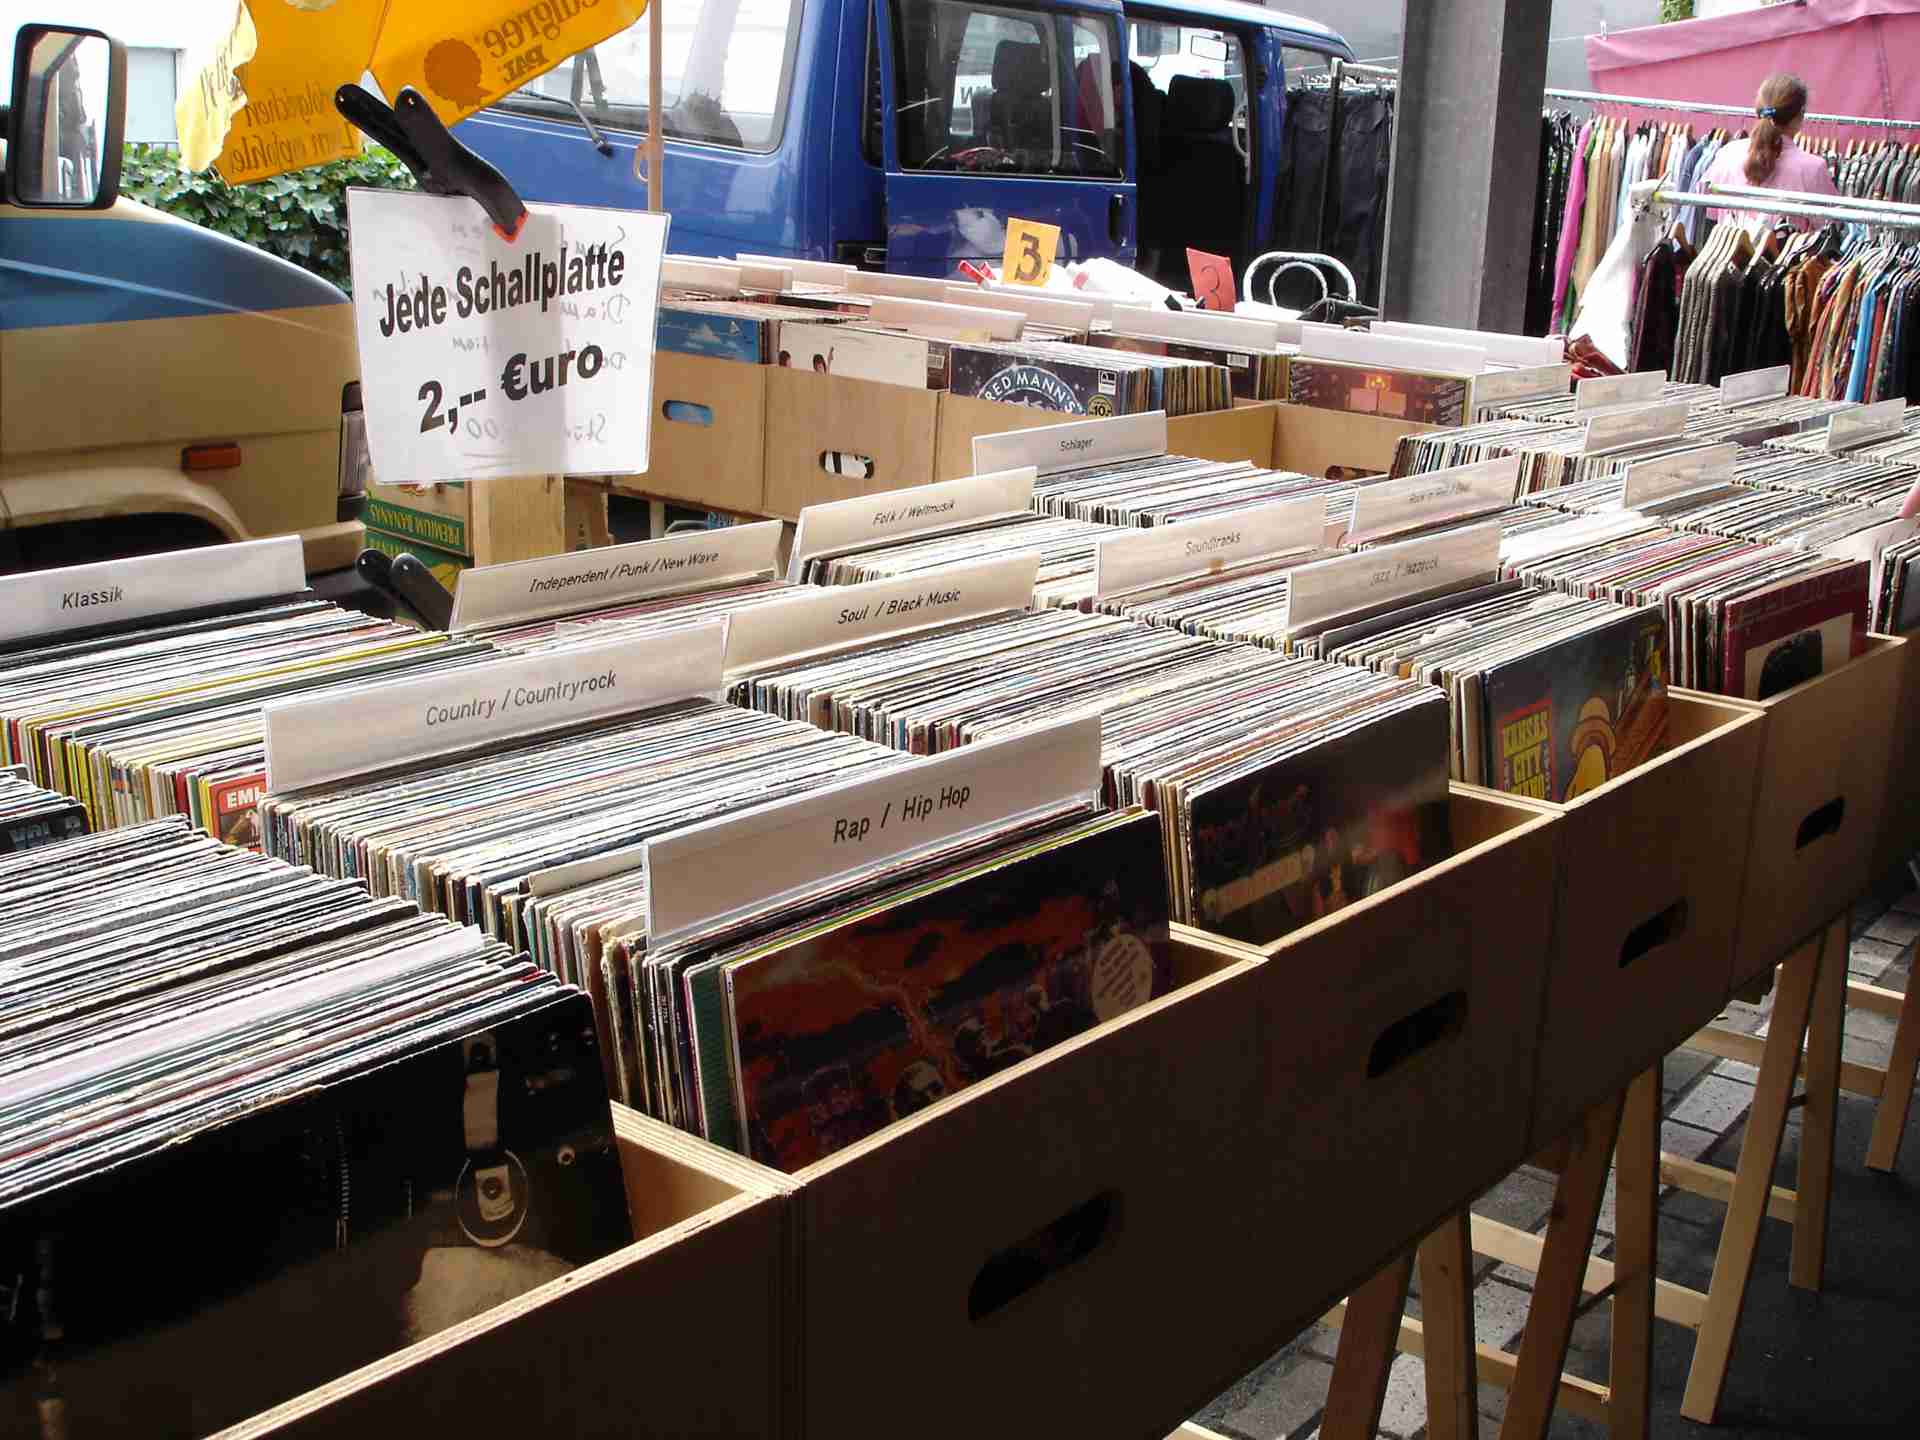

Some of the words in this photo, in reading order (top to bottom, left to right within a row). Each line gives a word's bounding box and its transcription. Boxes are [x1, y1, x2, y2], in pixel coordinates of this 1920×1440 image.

[379, 276, 447, 338] Jede
[456, 241, 625, 319] Schallplatte
[500, 344, 604, 401] €uro
[1016, 372, 1075, 412] MANN'S
[415, 517, 461, 546] PREMIUM
[873, 511, 896, 527] Folk
[1184, 531, 1241, 556] Soundtracks
[529, 568, 609, 593] Independent
[618, 562, 649, 577] Punk
[659, 557, 688, 572] New
[688, 552, 719, 566] Wave
[62, 586, 123, 609] Klassik
[838, 604, 870, 624] Soul
[875, 601, 885, 616] /
[886, 595, 924, 615] Black
[926, 590, 960, 607] Music
[426, 698, 497, 726] Country
[502, 688, 511, 711] /
[514, 670, 617, 707] Countryrock
[227, 786, 260, 809] EMI
[833, 817, 870, 843] Rap
[880, 802, 891, 828] /
[902, 795, 933, 822] Hip
[938, 786, 970, 810] Hop
